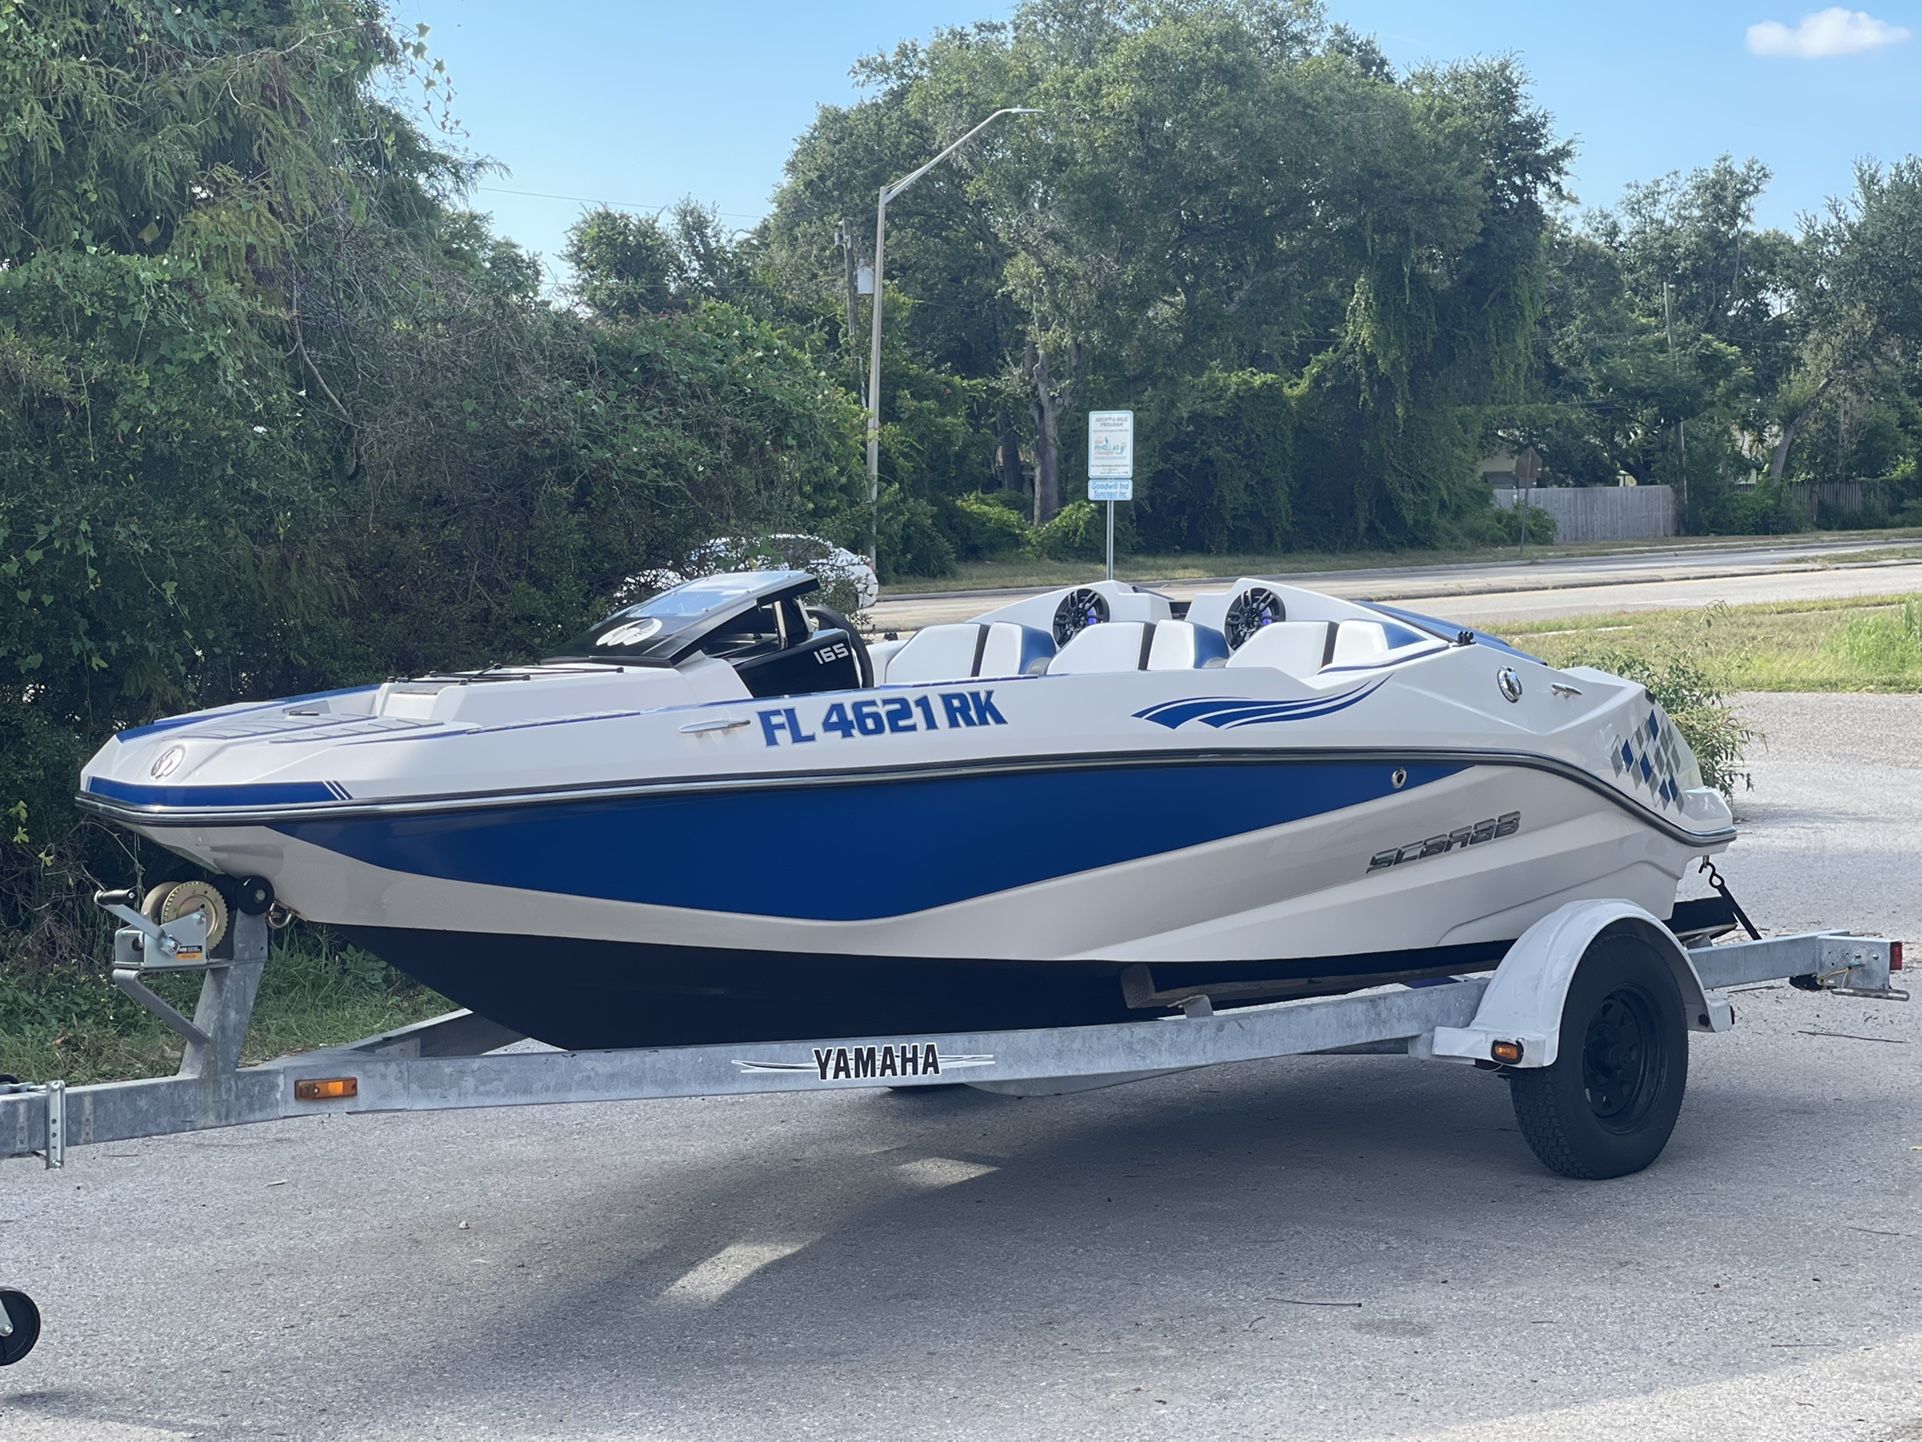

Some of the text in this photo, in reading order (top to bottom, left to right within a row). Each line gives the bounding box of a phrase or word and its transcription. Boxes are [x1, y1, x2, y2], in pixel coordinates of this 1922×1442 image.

[813, 642, 850, 665] 165
[756, 689, 1009, 747] FL 4621 RK
[1365, 810, 1522, 875] SCARAB
[812, 1042, 941, 1081] YAMAHA
